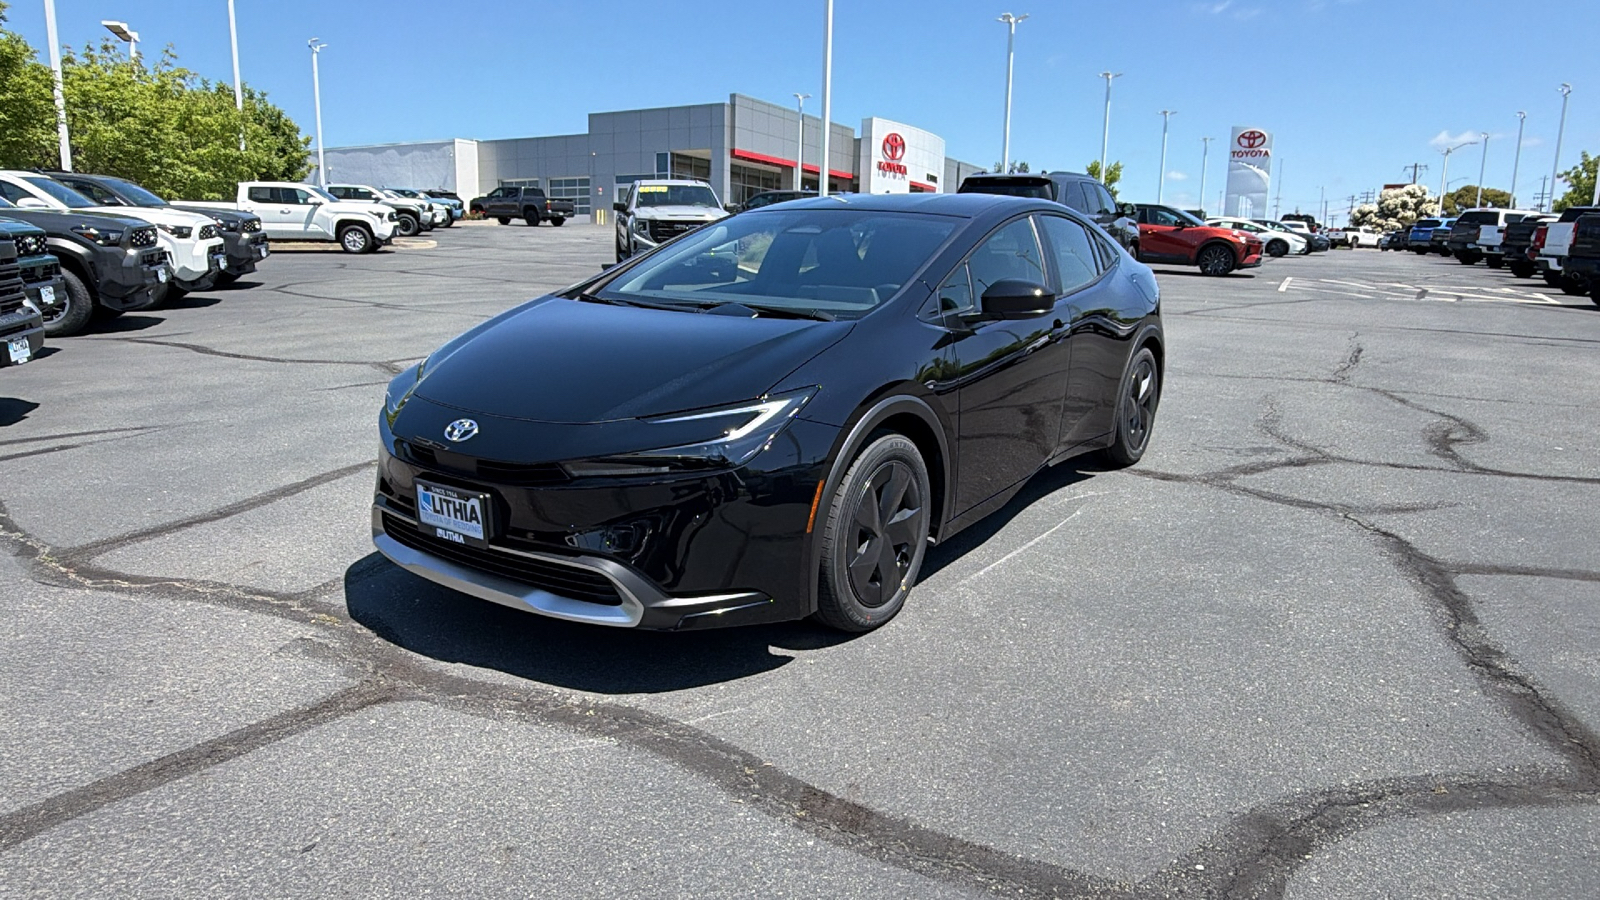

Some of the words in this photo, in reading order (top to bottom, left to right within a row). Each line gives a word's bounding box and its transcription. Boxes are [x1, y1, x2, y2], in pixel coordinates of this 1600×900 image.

[1231, 150, 1269, 158] TOYOTA
[877, 161, 907, 175] TOYOTA
[431, 486, 445, 496] SINCE
[432, 494, 481, 525] LITHIA
[421, 511, 443, 523] TOYOTA
[443, 517, 452, 525] OF
[453, 519, 482, 534] REDDING
[442, 529, 465, 544] LITHIA
